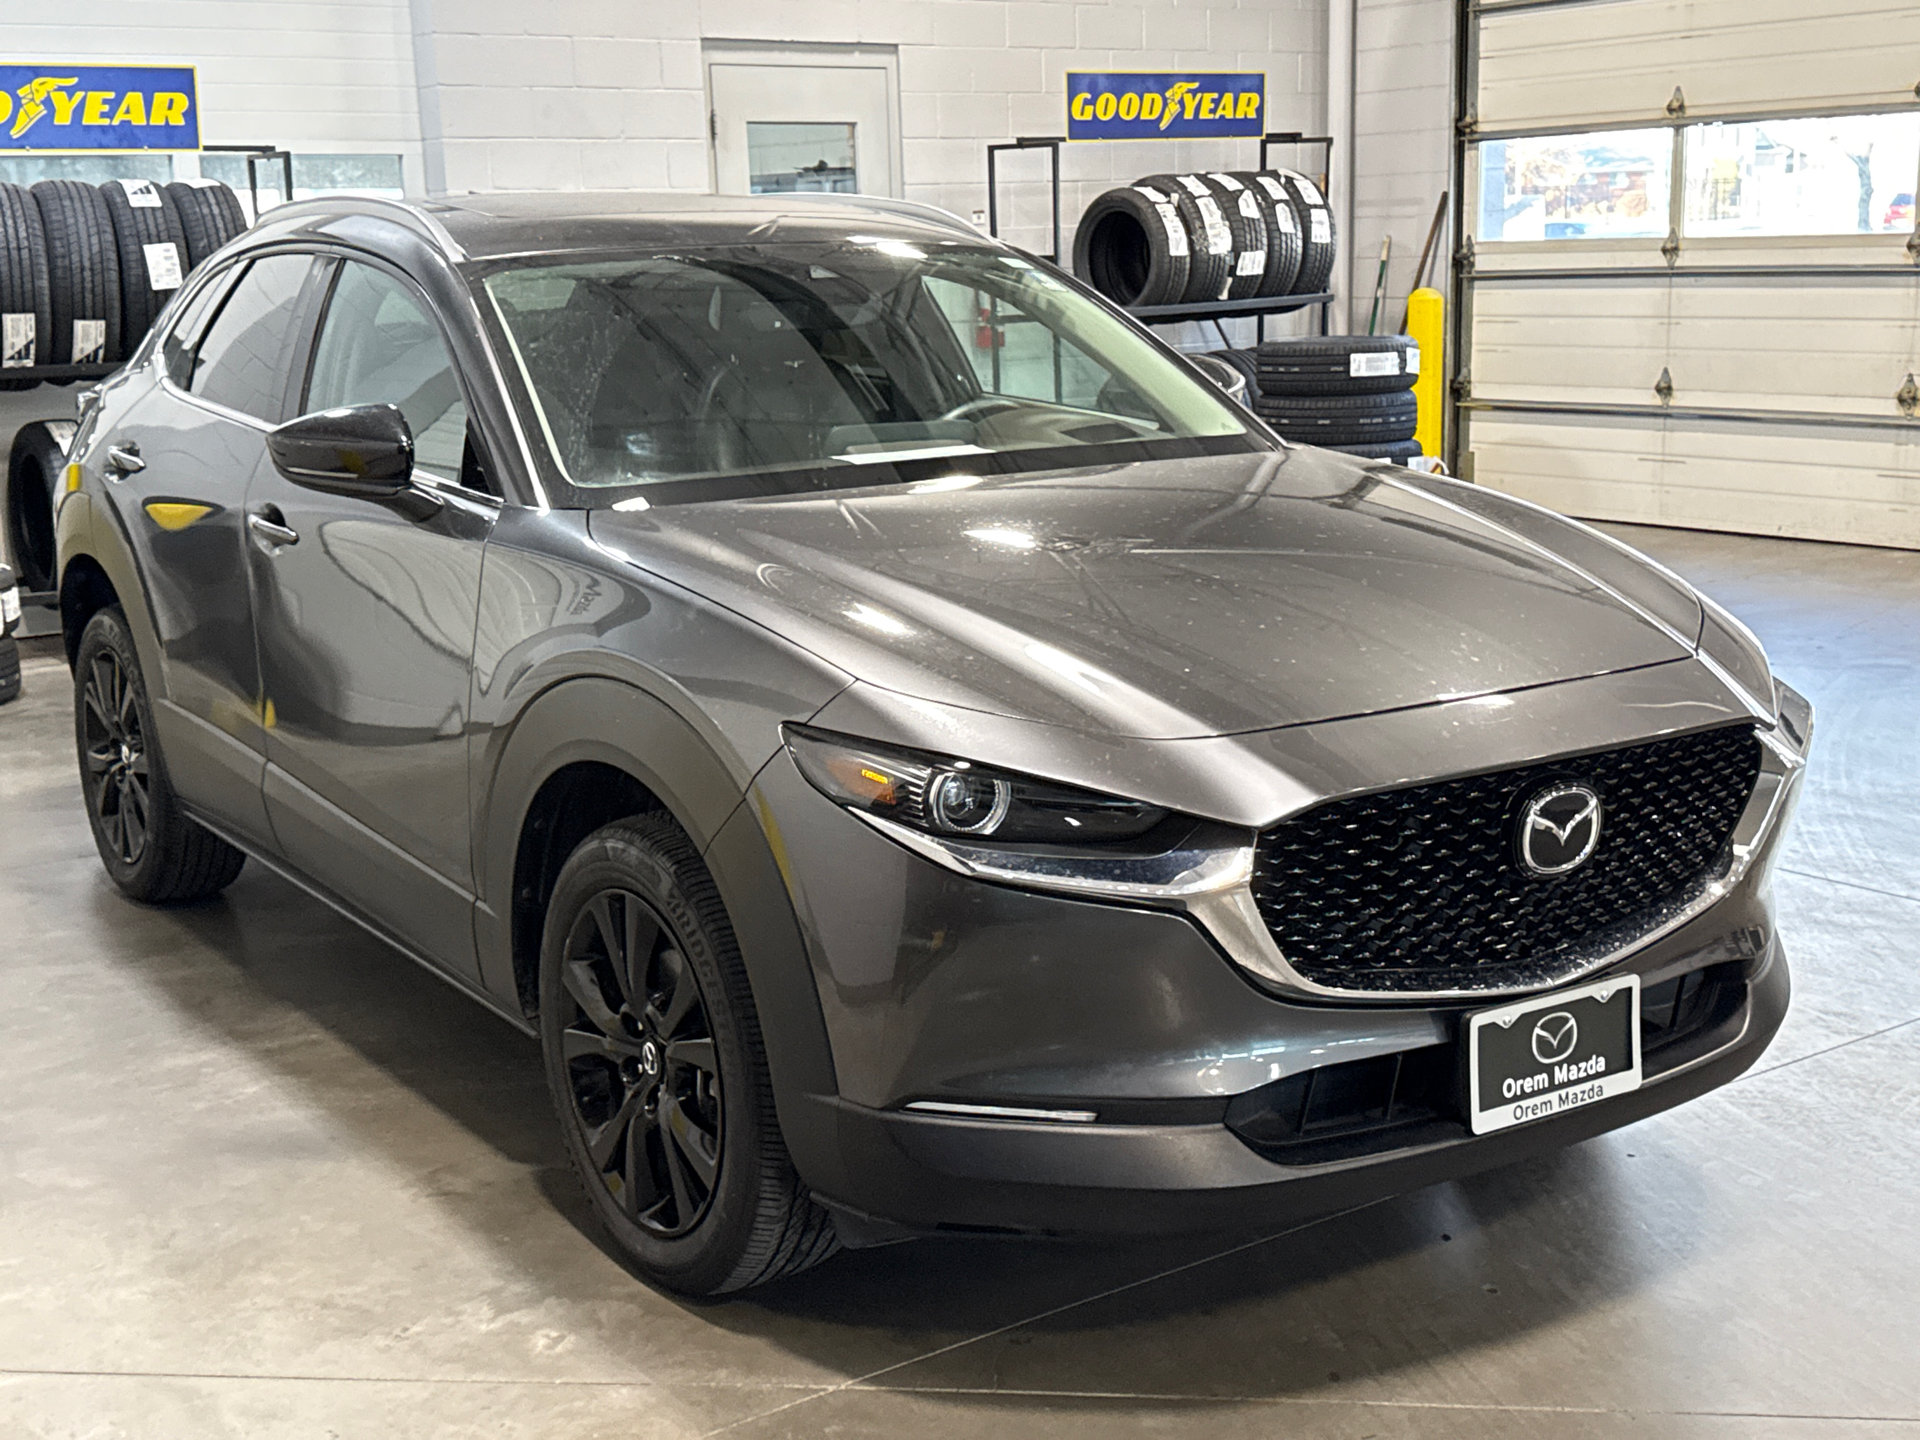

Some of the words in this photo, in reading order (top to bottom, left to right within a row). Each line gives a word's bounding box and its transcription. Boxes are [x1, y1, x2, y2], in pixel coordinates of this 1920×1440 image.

[1071, 91, 1261, 122] GOODYEAR
[1502, 1073, 1549, 1098] Orem
[1554, 1054, 1606, 1086] Mazda
[1513, 1098, 1553, 1121] Orem
[1558, 1084, 1604, 1109] Mazda
